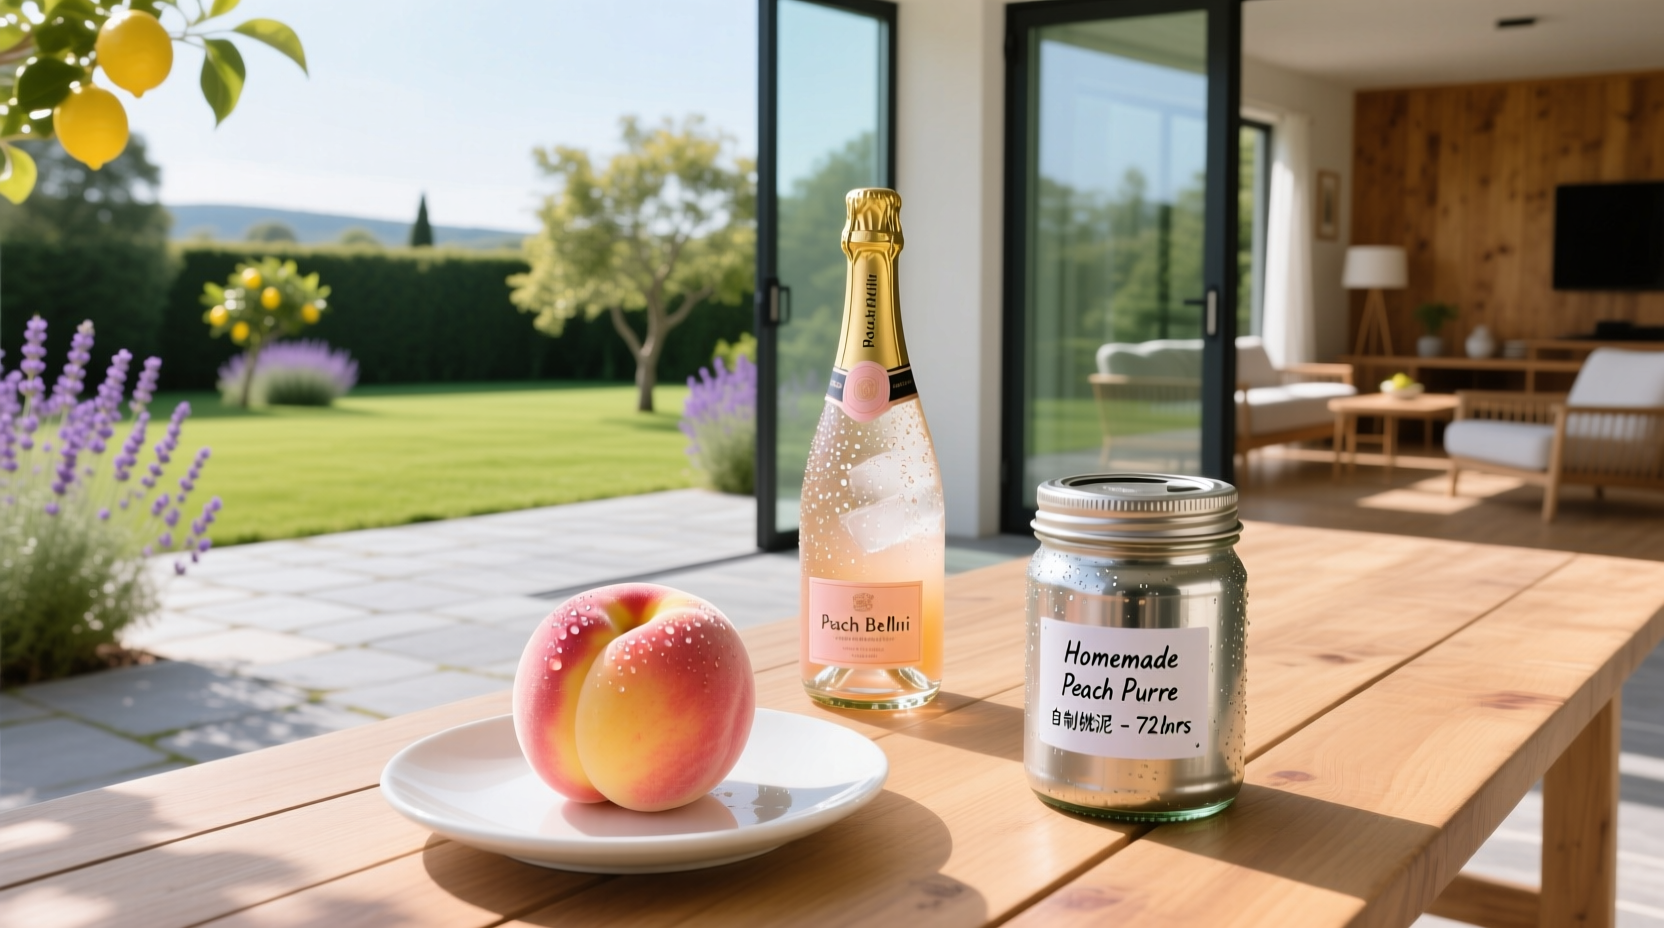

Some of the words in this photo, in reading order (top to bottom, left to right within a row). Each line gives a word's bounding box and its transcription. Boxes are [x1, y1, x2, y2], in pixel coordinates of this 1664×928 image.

[1064, 639, 1179, 669] Homemade
[1061, 672, 1113, 700] Peach
[1121, 677, 1178, 702] Purre
